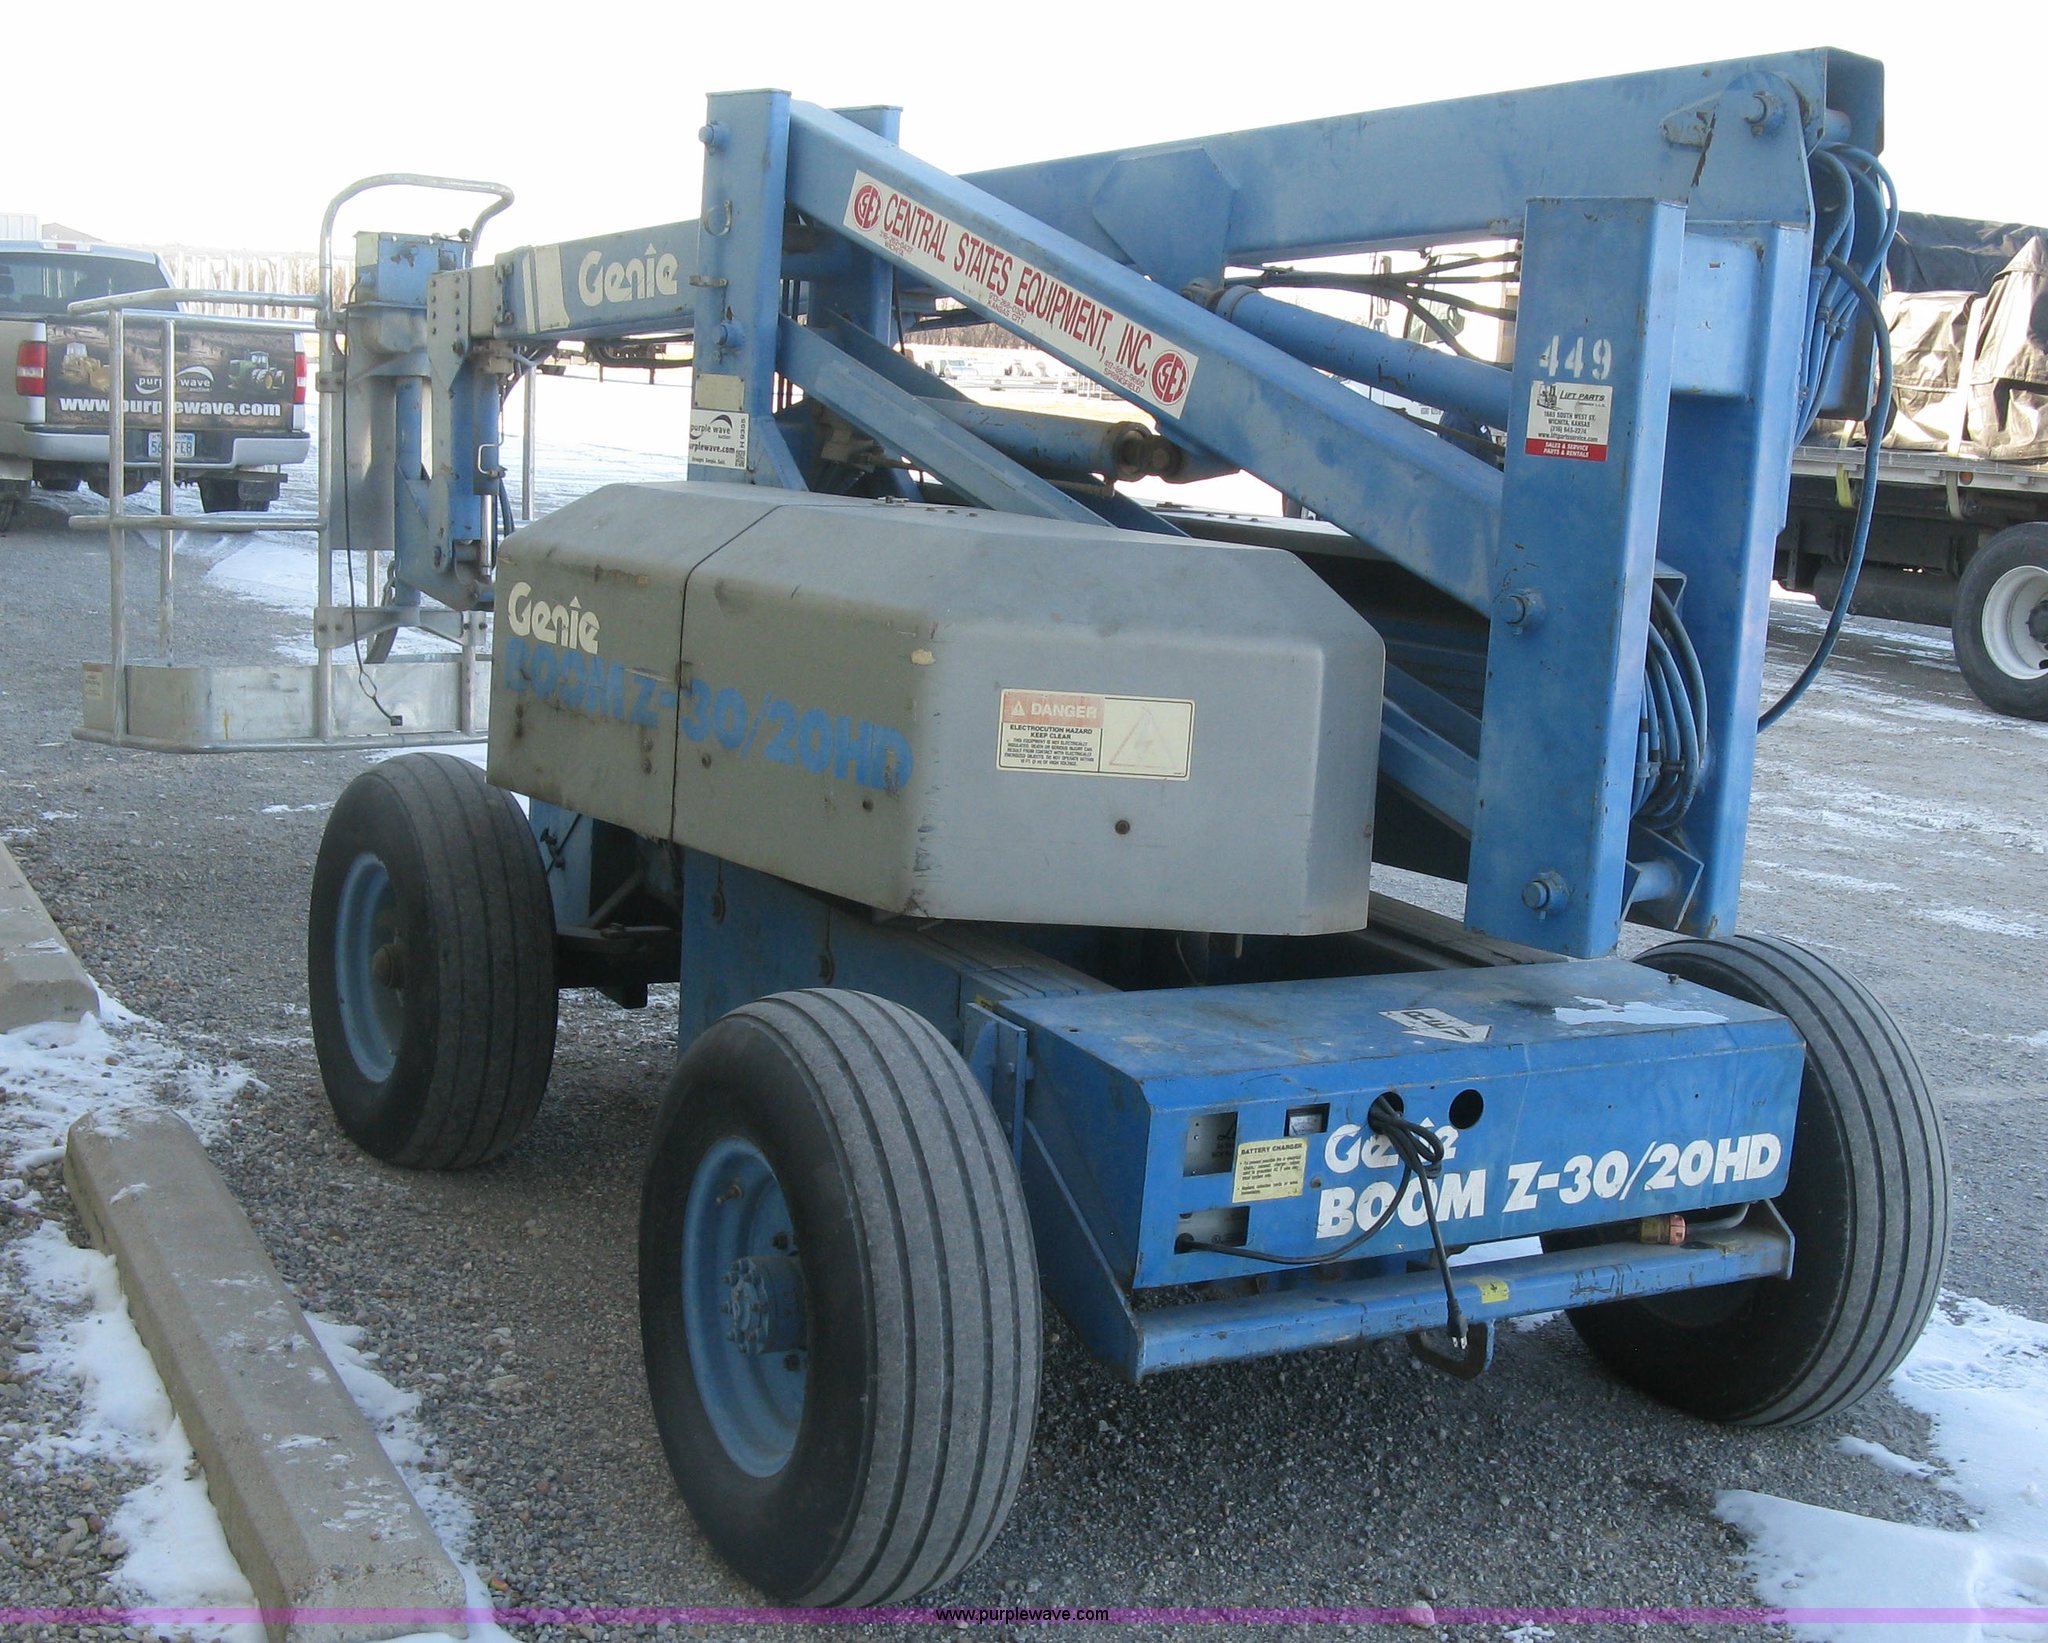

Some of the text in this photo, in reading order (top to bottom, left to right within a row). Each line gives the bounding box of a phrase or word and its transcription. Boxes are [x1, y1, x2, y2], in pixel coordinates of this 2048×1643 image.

[578, 243, 678, 307] Genie
[883, 193, 1152, 378] CENTRAL STATES EQUIPMENT, INC.
[1538, 334, 1612, 381] 449
[1578, 393, 1605, 402] PARTS
[508, 581, 600, 655] Genie
[504, 636, 914, 790] BOOM Z-30/20HD
[1010, 725, 1064, 733] ELECTROCUTION
[1031, 703, 1097, 718] DANGER
[1401, 1010, 1471, 1039] REV
[1241, 1146, 1270, 1155] BATTERY
[1272, 1143, 1303, 1152] CHARGER
[1316, 1132, 1782, 1239] BOOM Z-30/20HD
